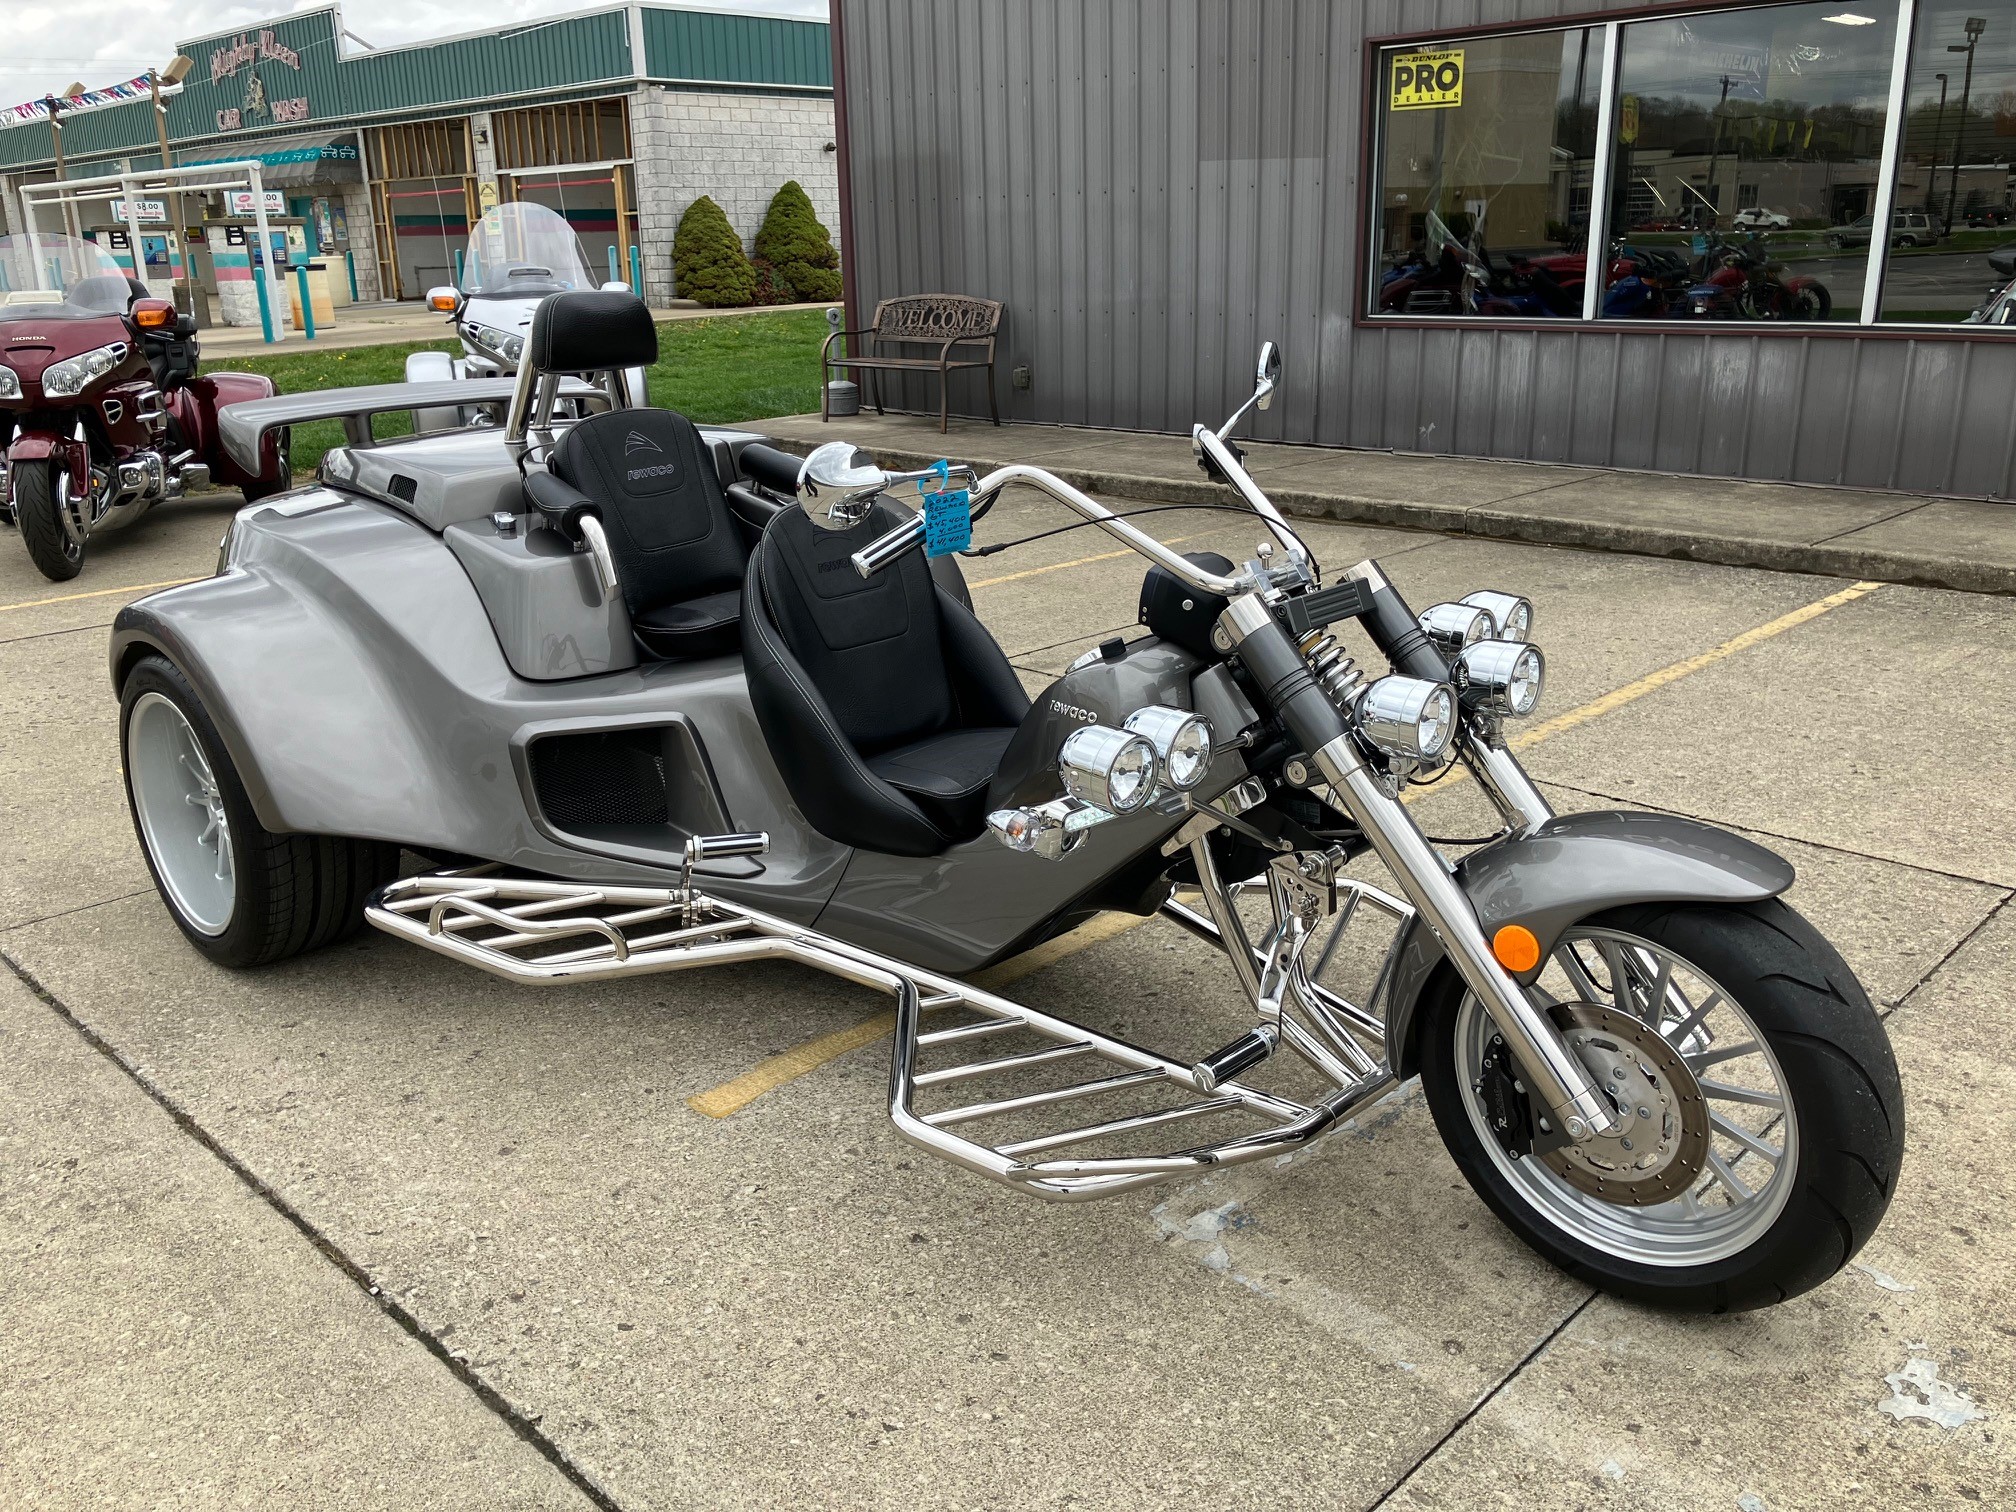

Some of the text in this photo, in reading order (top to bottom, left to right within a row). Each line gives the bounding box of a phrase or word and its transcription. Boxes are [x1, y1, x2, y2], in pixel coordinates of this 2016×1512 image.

[1411, 53, 1452, 63] DUNLOP
[1394, 61, 1460, 95] PRO
[1393, 92, 1459, 103] DEALER
[216, 97, 309, 131] CAR WASH
[892, 308, 984, 329] WELCOME
[627, 463, 675, 480] rewaco
[817, 556, 854, 574] rewa
[1049, 699, 1098, 724] rewaco
